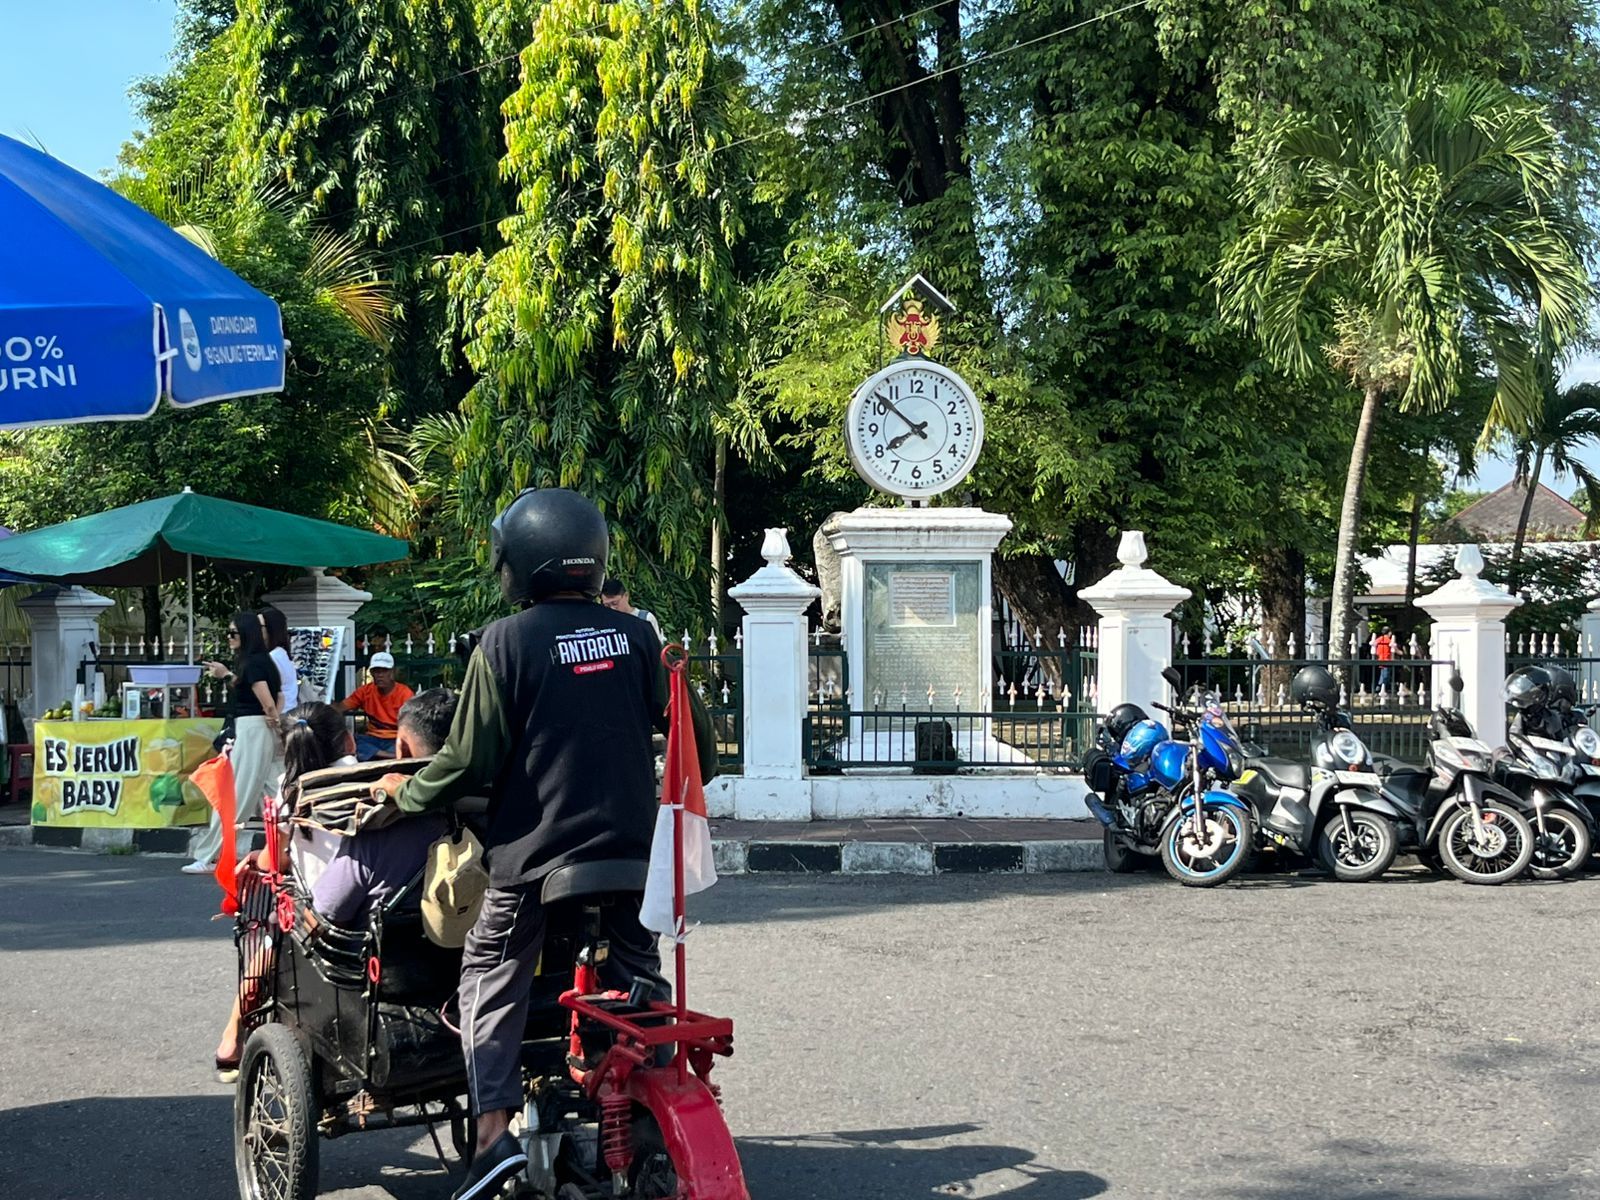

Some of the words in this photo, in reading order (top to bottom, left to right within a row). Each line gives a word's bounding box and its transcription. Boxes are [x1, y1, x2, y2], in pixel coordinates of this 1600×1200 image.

[0, 335, 63, 361] 0%
[889, 385, 899, 400] 11
[910, 379, 924, 394] 12
[873, 401, 887, 416] 10
[947, 401, 956, 415] 2
[868, 422, 879, 437] 9
[953, 422, 962, 436] 3
[875, 444, 884, 458] 8
[948, 444, 957, 457] 4
[890, 460, 900, 474] 7
[911, 465, 921, 479] 6
[933, 460, 942, 473] 5
[45, 739, 68, 772] ES
[73, 736, 139, 773] JERUK
[62, 780, 120, 811] BABY
